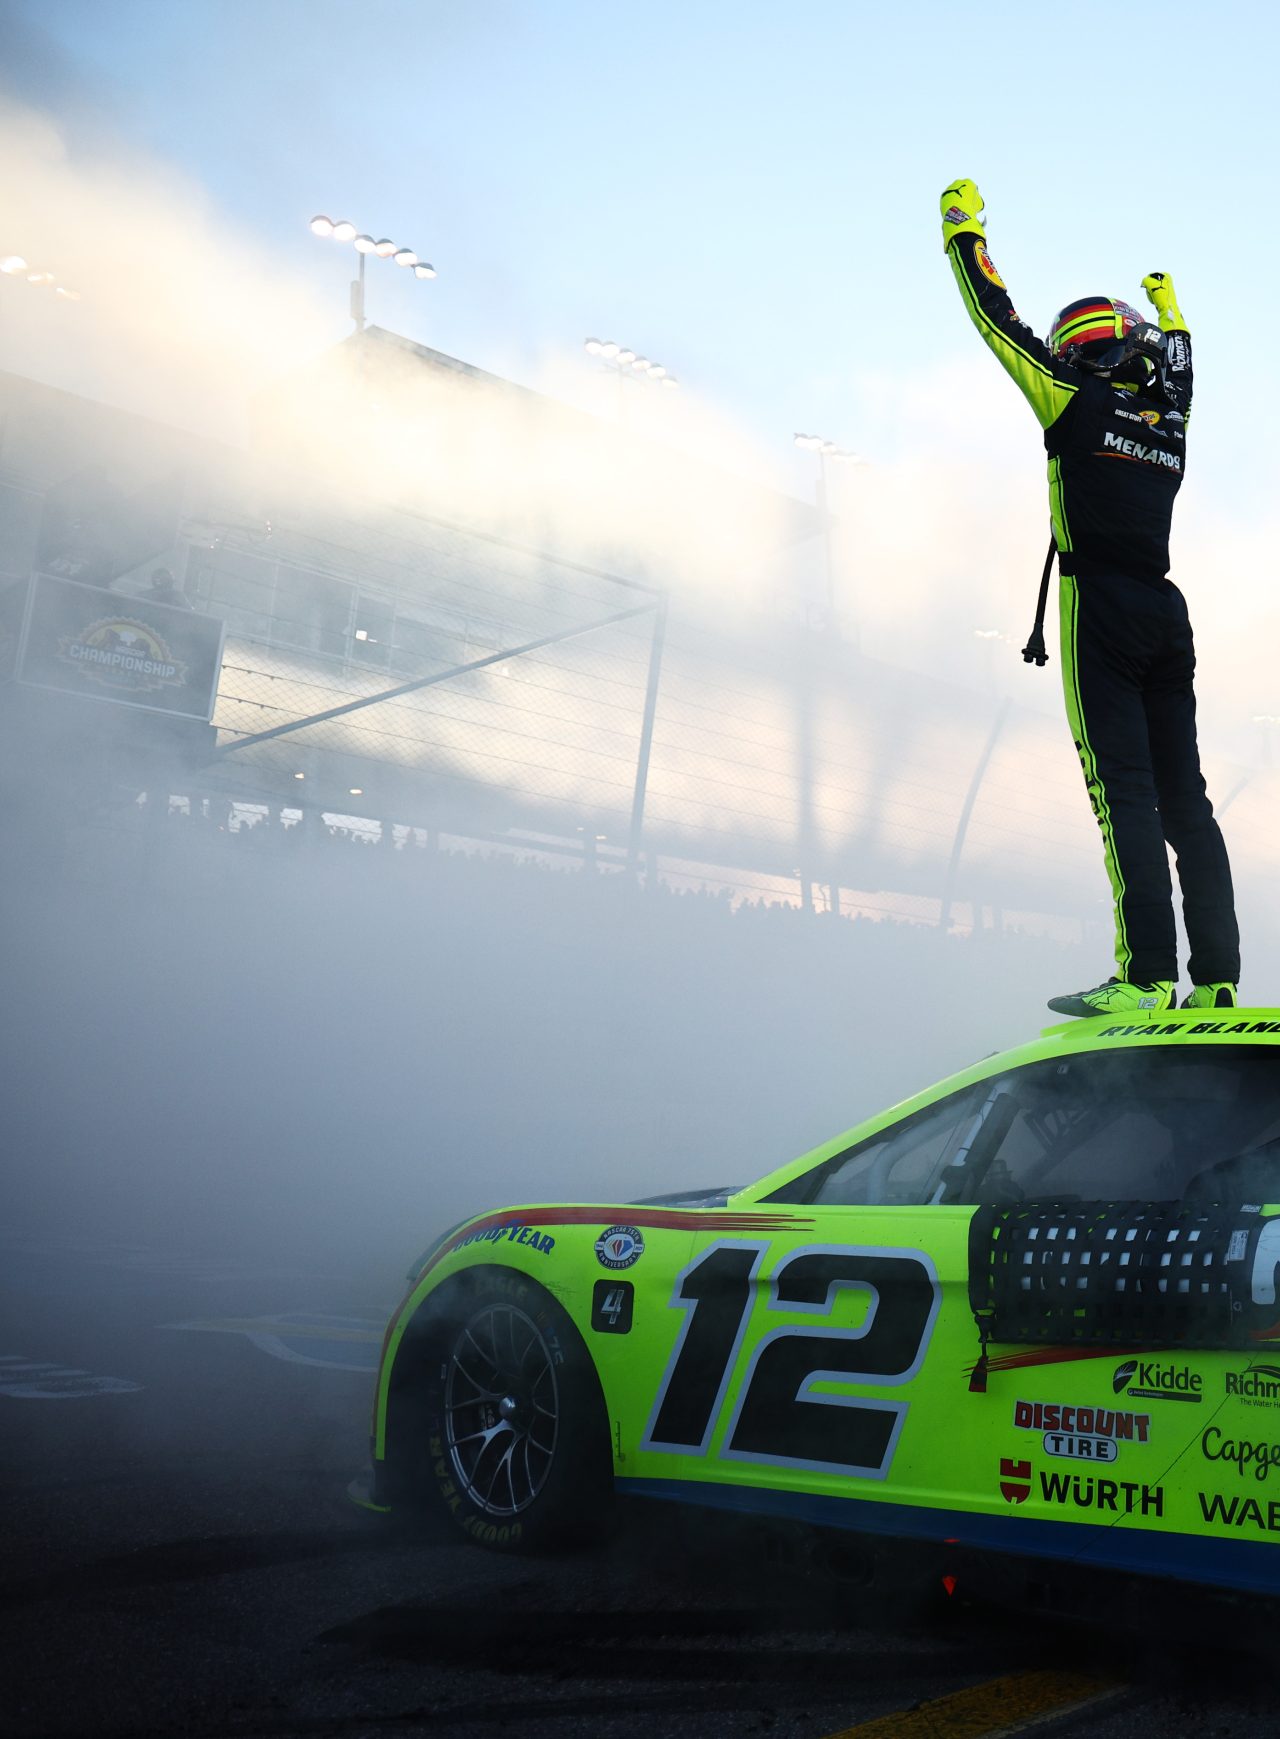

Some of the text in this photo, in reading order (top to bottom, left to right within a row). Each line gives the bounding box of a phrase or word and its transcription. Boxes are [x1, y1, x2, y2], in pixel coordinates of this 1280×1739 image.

[1144, 328, 1162, 343] 12
[1103, 431, 1181, 469] MENARDS
[70, 644, 176, 678] CHAMPIONSHIP
[1137, 996, 1159, 1009] 12
[1097, 1023, 1185, 1037] RYAN
[601, 1288, 625, 1325] 4
[640, 1238, 943, 1479] 12
[1139, 1362, 1202, 1392] Kidde
[1240, 1397, 1252, 1406] The
[1252, 1399, 1272, 1408] Water
[1013, 1400, 1150, 1443] DISCOUNT
[1050, 1436, 1109, 1459] TIRE
[1039, 1471, 1164, 1517] WÜRTH
